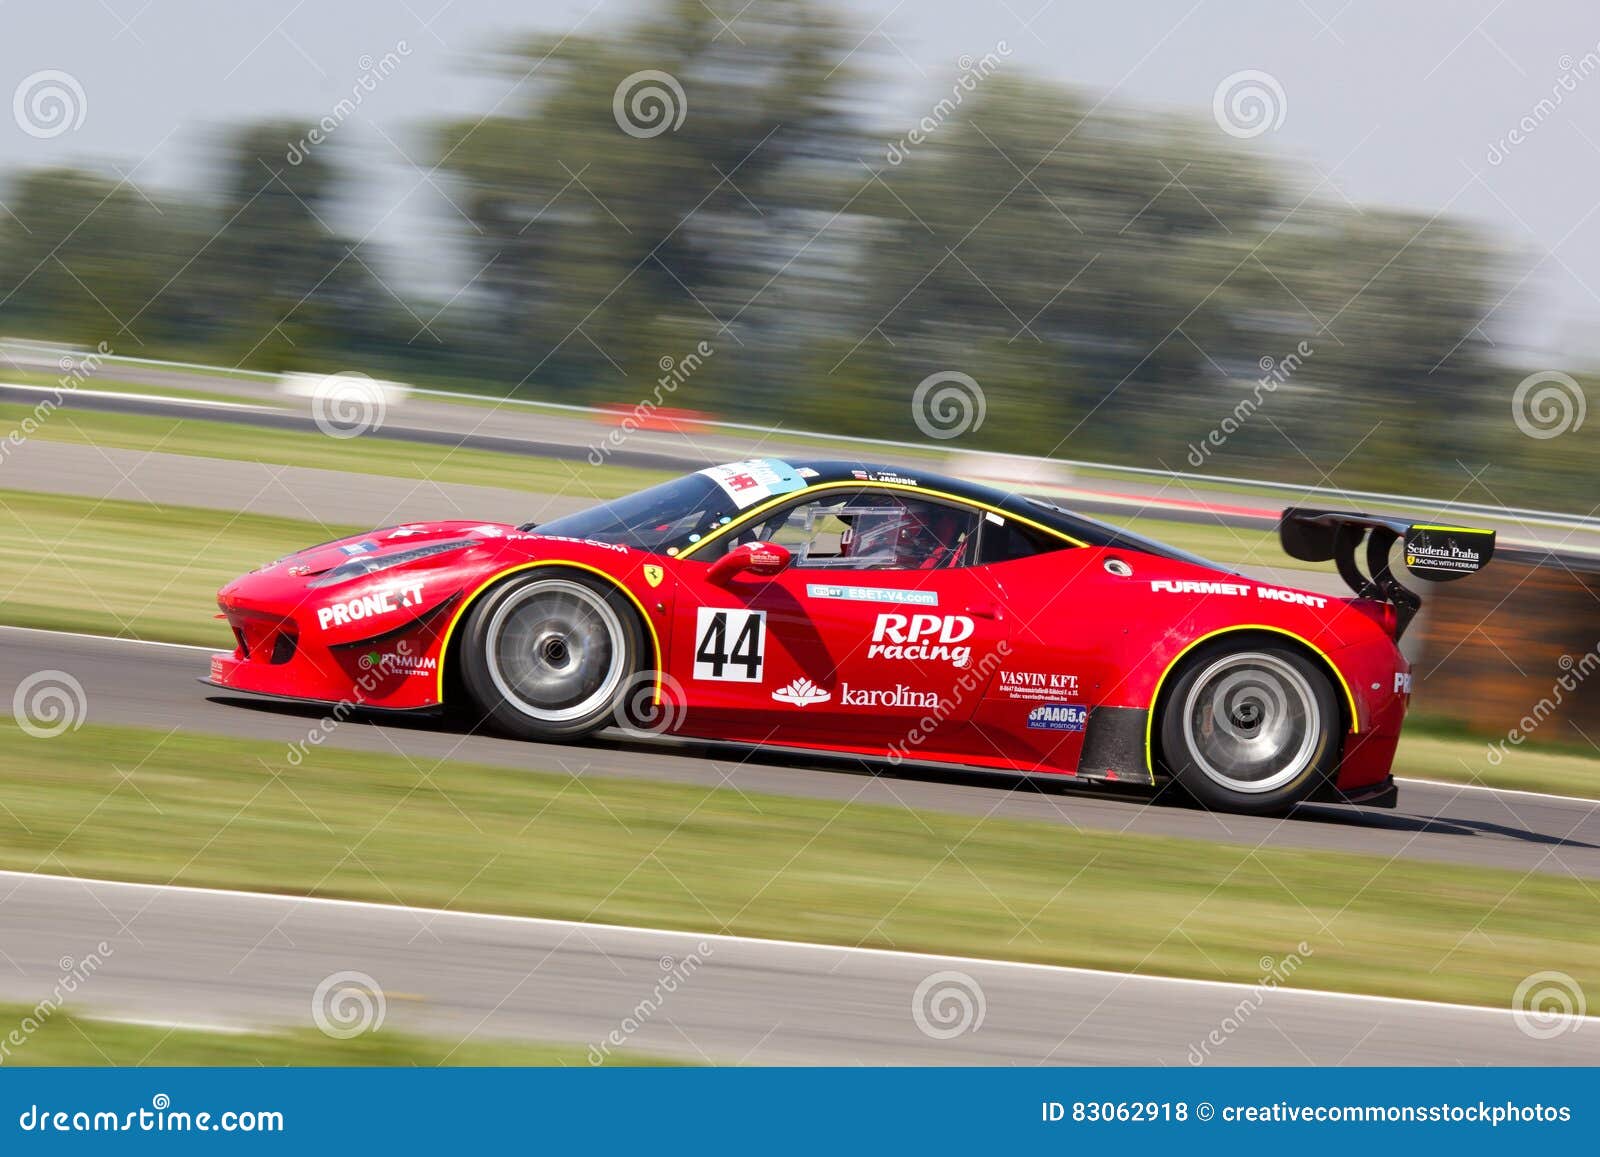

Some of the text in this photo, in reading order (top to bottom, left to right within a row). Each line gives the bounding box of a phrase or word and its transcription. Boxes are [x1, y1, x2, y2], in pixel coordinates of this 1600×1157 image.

[1407, 542, 1480, 560] Scuderia Praha
[1416, 558, 1438, 566] RACING
[1455, 561, 1479, 569] FERRARI
[317, 582, 425, 631] PRONEXT
[848, 587, 934, 603] ESET-V4.com
[1150, 580, 1327, 609] FURMET MONT
[871, 612, 975, 644] RPD
[696, 612, 763, 679] 44
[867, 639, 971, 668] racing
[1000, 671, 1079, 688] VASVIN KFT.
[840, 682, 939, 709] karolína
[1049, 722, 1077, 730] POSITION
